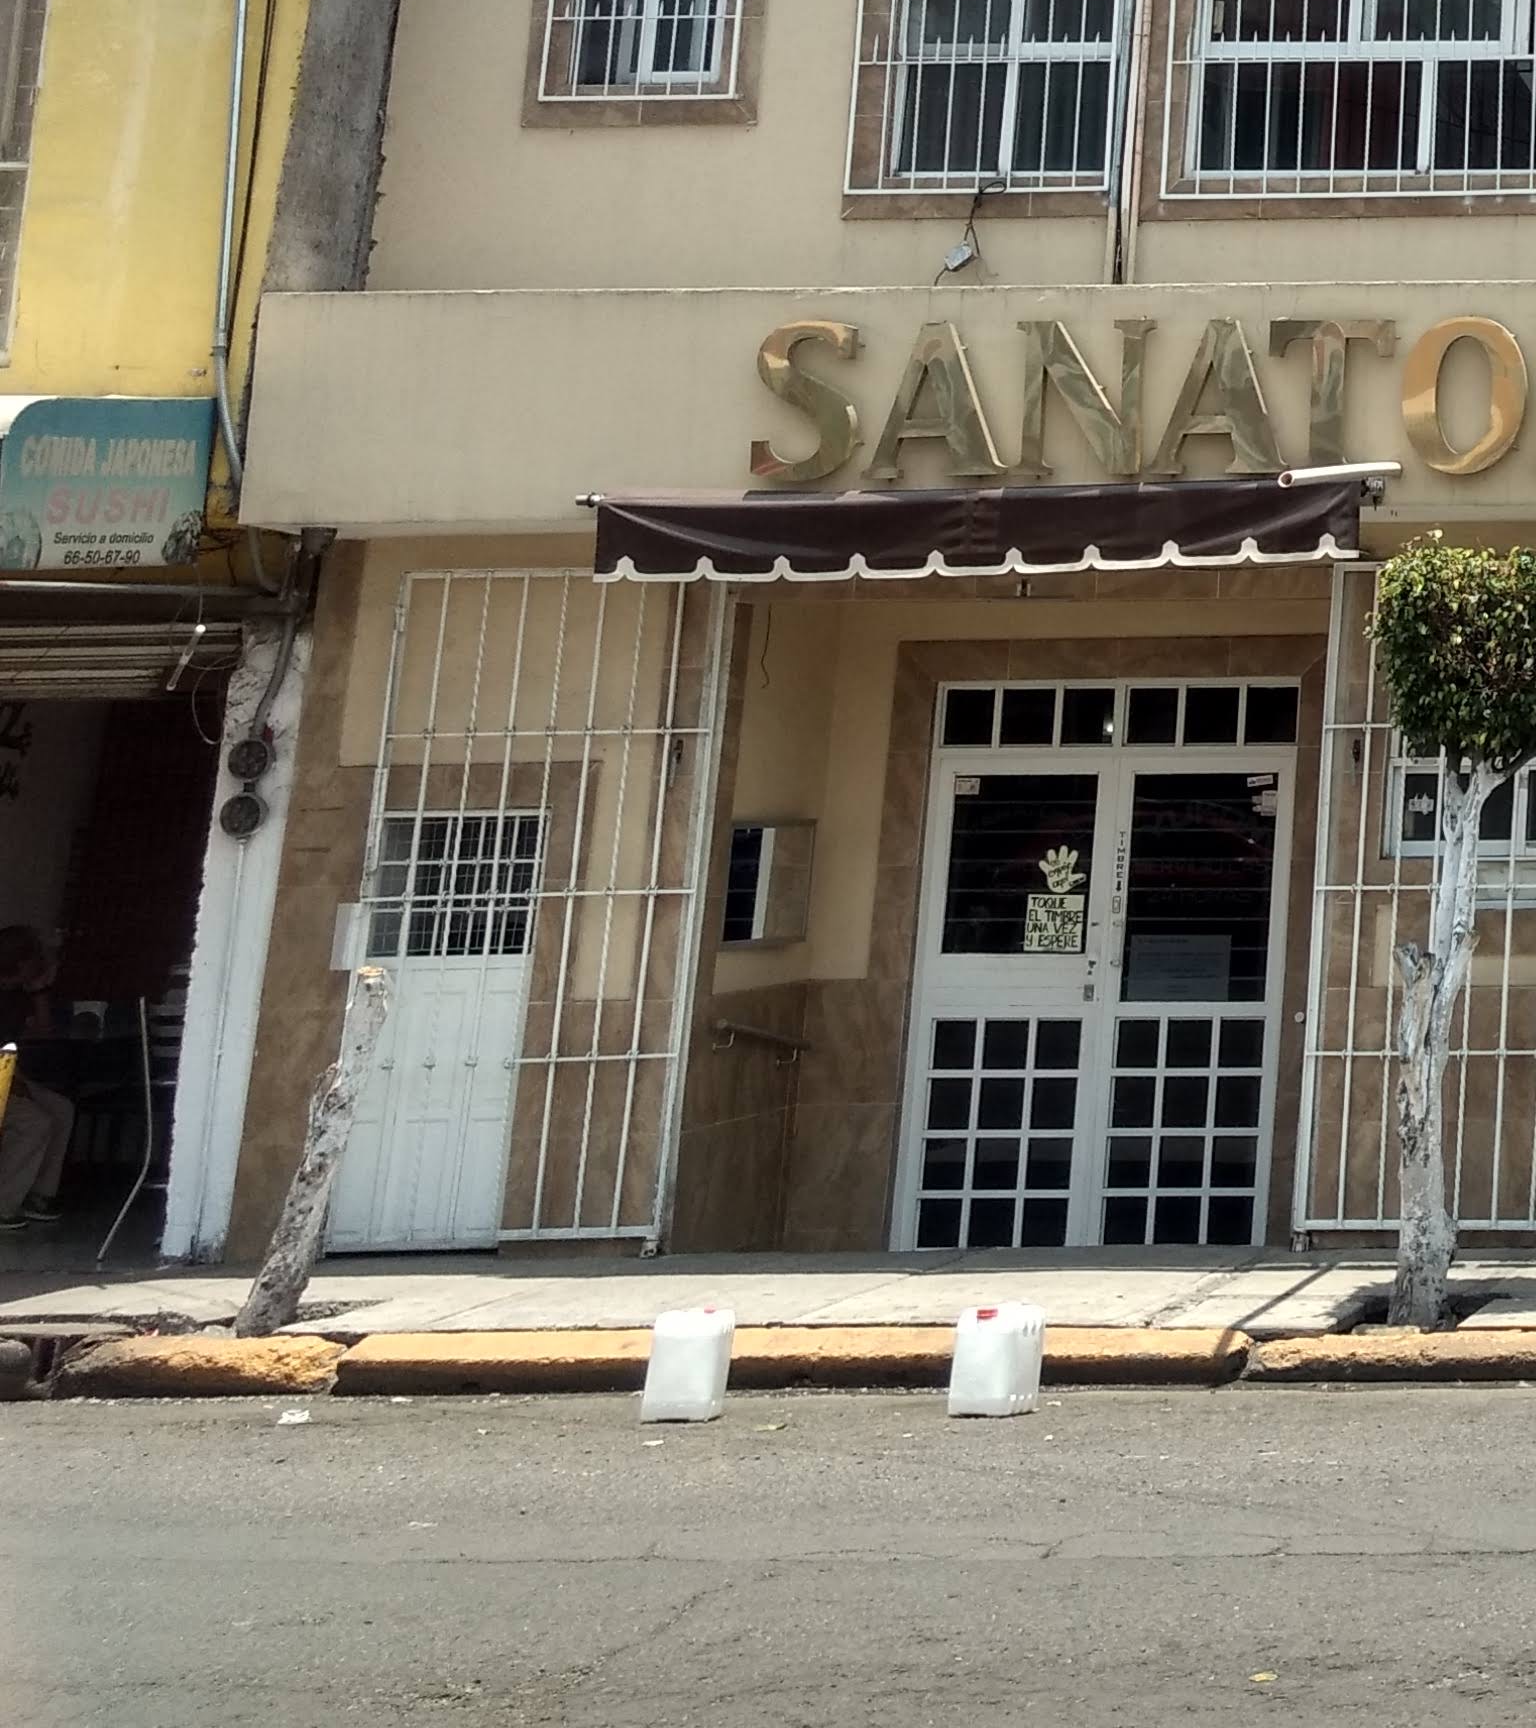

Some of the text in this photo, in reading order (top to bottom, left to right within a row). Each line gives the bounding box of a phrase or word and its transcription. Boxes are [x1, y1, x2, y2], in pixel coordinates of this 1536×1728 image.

[47, 485, 170, 524] SUSHI
[53, 531, 96, 545] Servicio
[109, 531, 154, 545] domicilio
[63, 549, 141, 565] 66-50-67-90
[1031, 896, 1068, 910] TOQUE
[1028, 909, 1083, 924] EL TIMBRE
[1026, 922, 1078, 935] UNA VEZ
[1037, 934, 1079, 949] ESPERE
